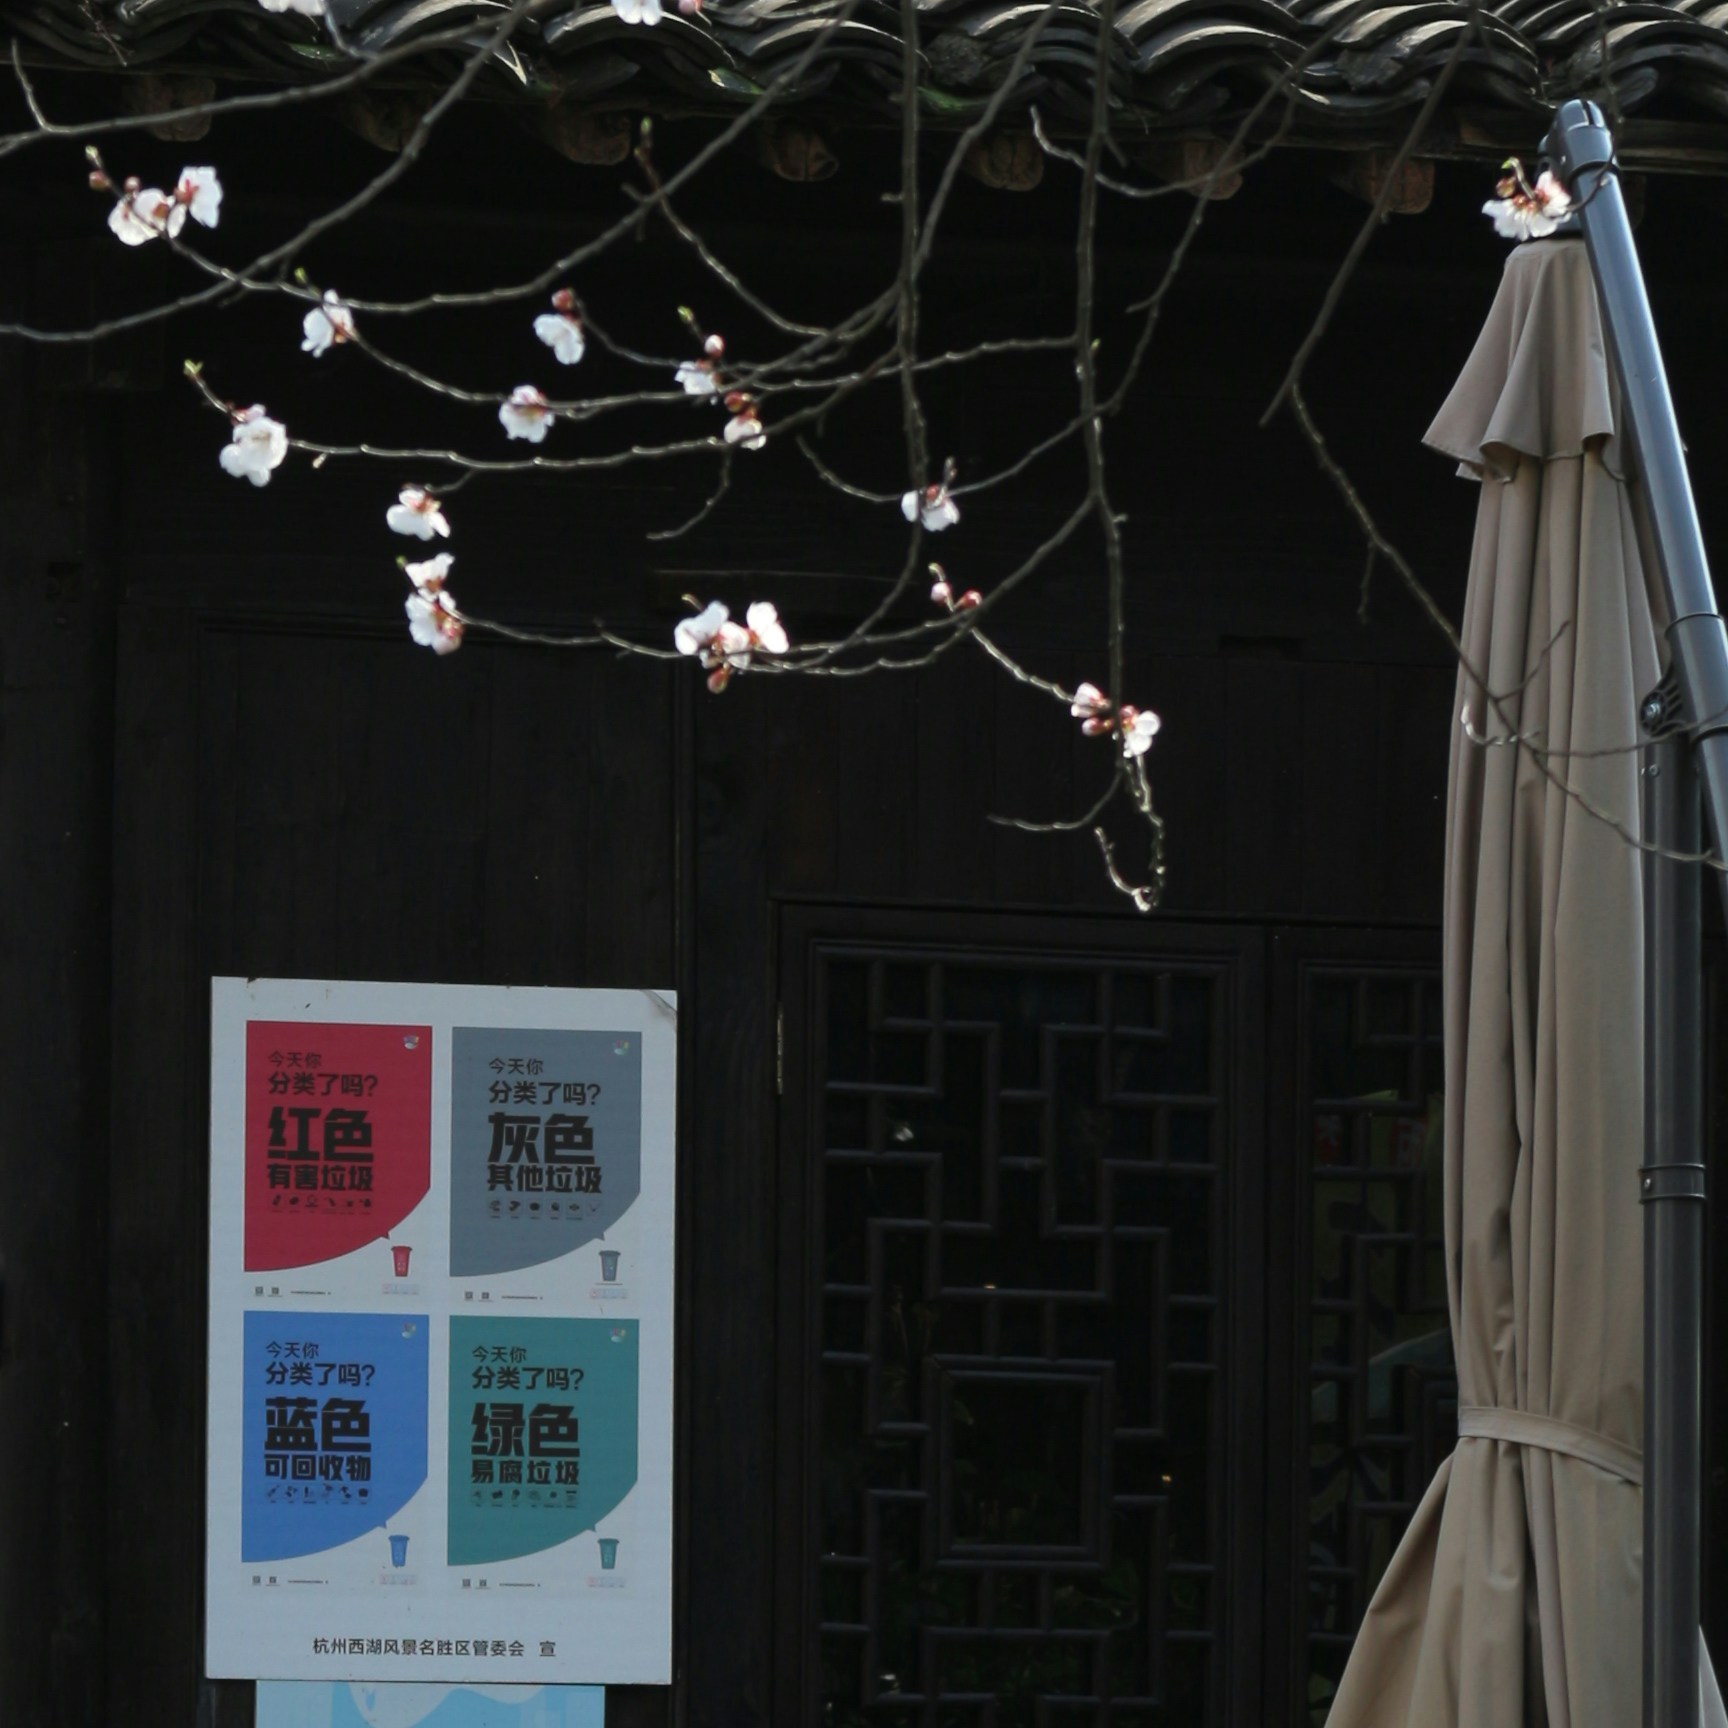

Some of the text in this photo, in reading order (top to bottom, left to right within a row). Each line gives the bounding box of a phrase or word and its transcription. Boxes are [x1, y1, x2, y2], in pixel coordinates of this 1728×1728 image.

[268, 1051, 322, 1069] 今天你
[489, 1058, 543, 1075] 今天你
[268, 1071, 378, 1097] 分类了吗?
[489, 1081, 600, 1105] 分类了吗?
[268, 1107, 373, 1162] 红色
[488, 1112, 594, 1164] 灰色
[267, 1163, 372, 1191] 有害垃圾
[487, 1164, 601, 1193] 其他垃圾
[266, 1341, 318, 1359] 今天你
[473, 1346, 526, 1363] 今天你
[266, 1362, 375, 1386] 分类了吗?
[472, 1366, 584, 1391] 分类了吗?
[265, 1397, 371, 1452] 蓝色
[472, 1403, 580, 1457] 绿色
[264, 1454, 371, 1481] 可回收物
[472, 1459, 579, 1485] 易腐垃圾
[313, 1638, 555, 1656] 杭州西湖风景名胜区管委会 宣
